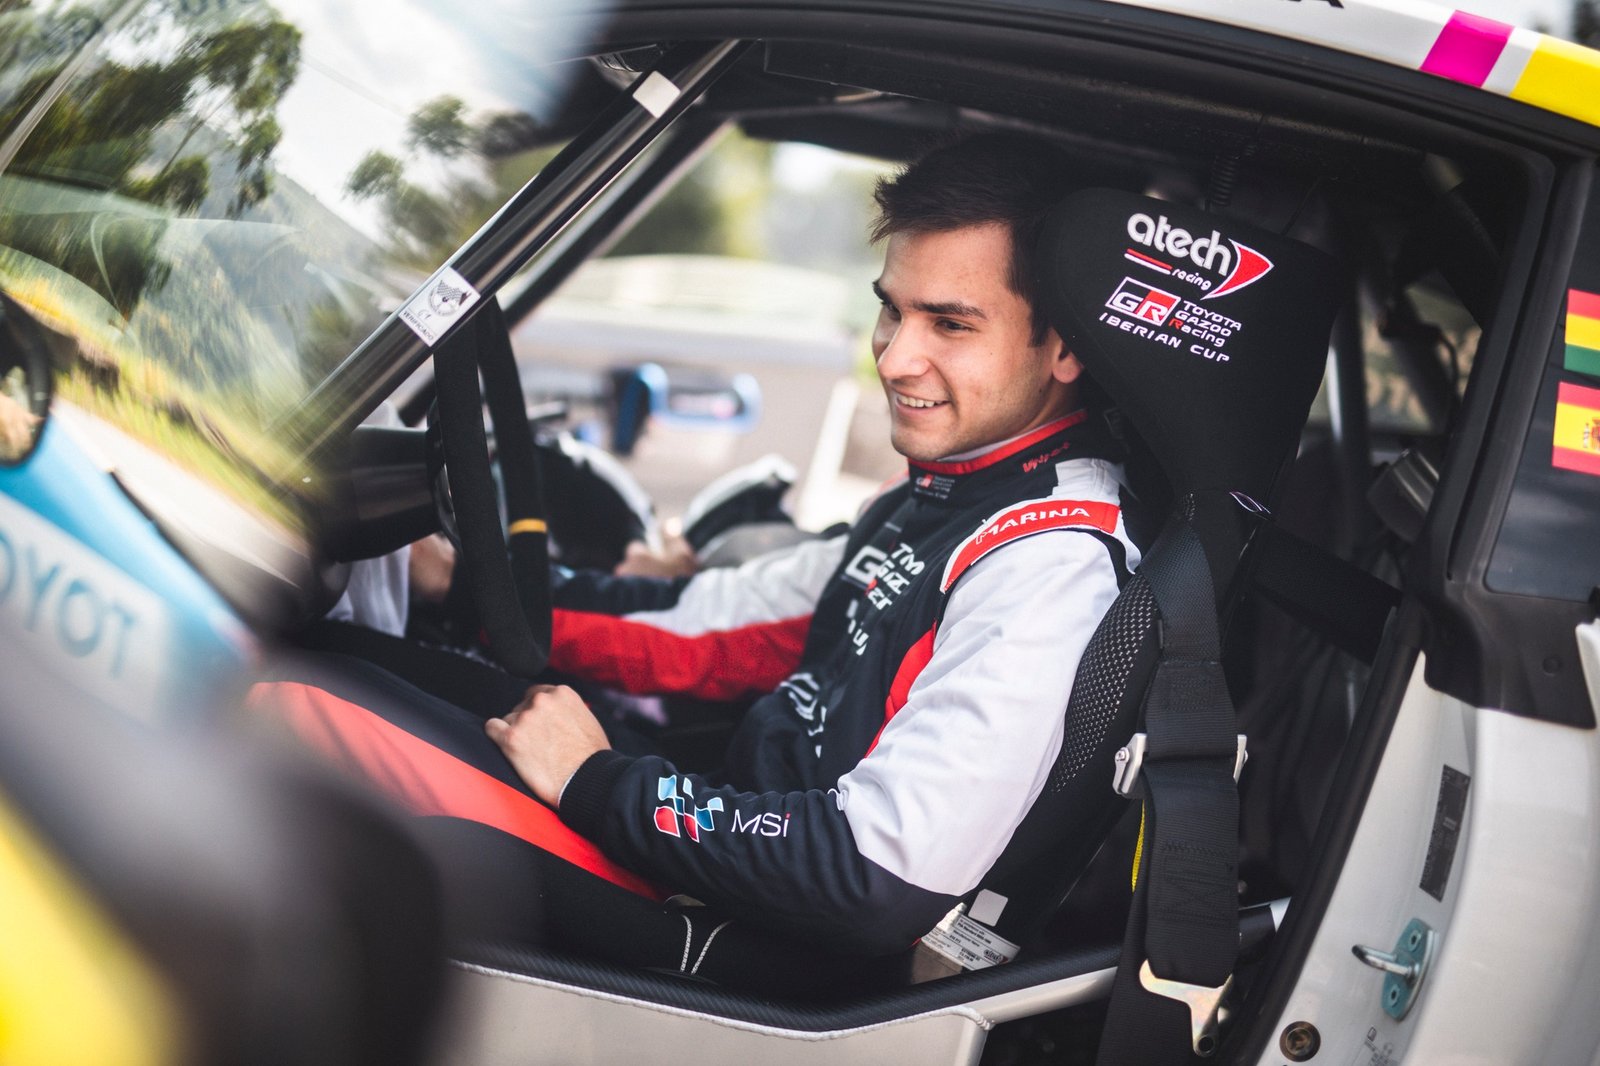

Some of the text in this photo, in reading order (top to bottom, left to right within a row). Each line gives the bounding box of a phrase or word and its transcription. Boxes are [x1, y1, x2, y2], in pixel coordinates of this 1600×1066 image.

[1127, 213, 1232, 277] atech
[1171, 268, 1212, 291] racing
[1111, 291, 1169, 324] GR
[1175, 309, 1232, 337] GAZOO
[1183, 300, 1243, 332] TOYOTA
[1099, 312, 1230, 363] IBERIAN CUP
[1168, 318, 1226, 348] Racing
[976, 507, 1090, 545] MARINA
[730, 809, 791, 838] MSi
